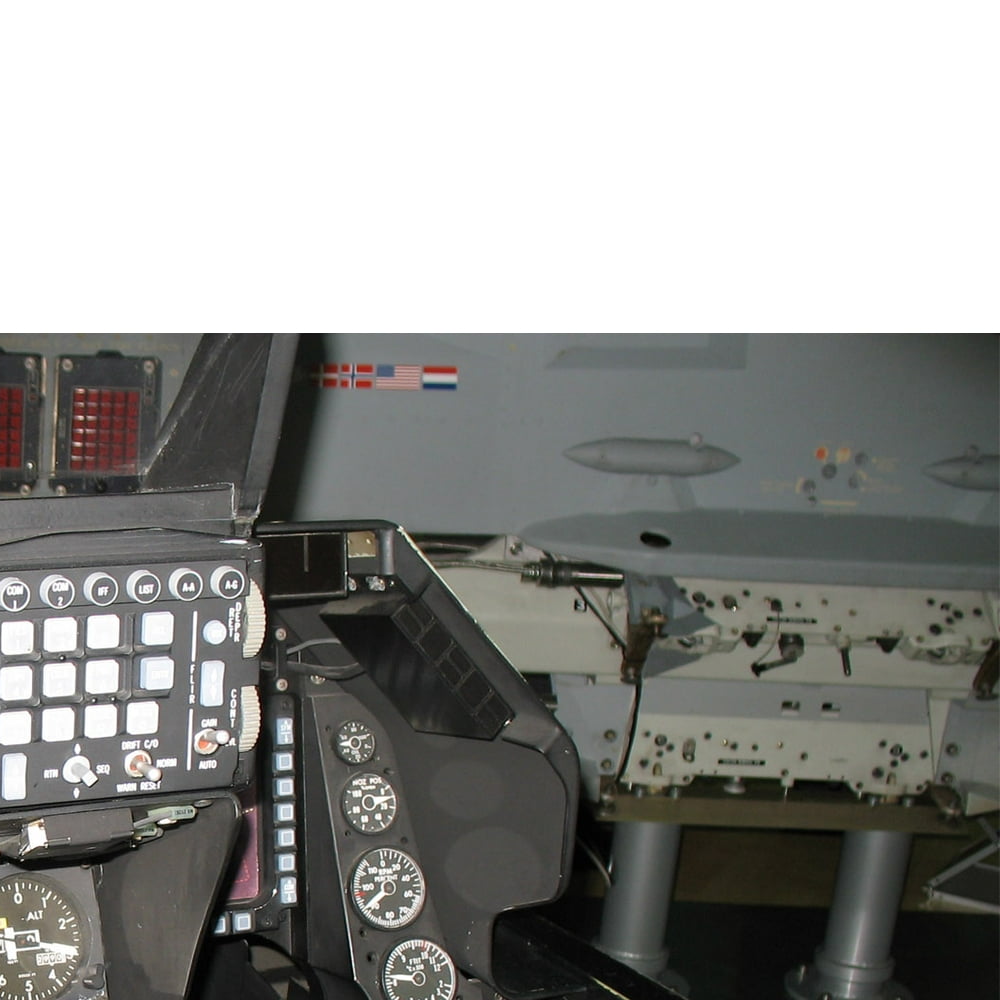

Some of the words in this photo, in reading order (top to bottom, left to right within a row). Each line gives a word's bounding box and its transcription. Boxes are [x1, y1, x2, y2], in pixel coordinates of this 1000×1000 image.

[6, 585, 24, 595] COM
[52, 582, 69, 592] COM
[138, 584, 155, 595] LIST
[181, 582, 196, 592] A-A
[224, 580, 239, 590] A-G
[97, 586, 110, 597] IFF
[57, 597, 63, 606] 2
[229, 688, 237, 728] CONT
[121, 740, 141, 751] DRIFT
[143, 739, 159, 749] C/O
[96, 764, 111, 775] SEQ
[199, 760, 217, 770] AUTO
[116, 782, 137, 793] WARN
[352, 778, 367, 786] NOZ
[362, 883, 375, 891] 100
[13, 892, 23, 904] 0
[26, 910, 44, 921] ALT
[58, 919, 67, 930] 2
[48, 969, 56, 979] 4
[25, 980, 34, 992] 5
